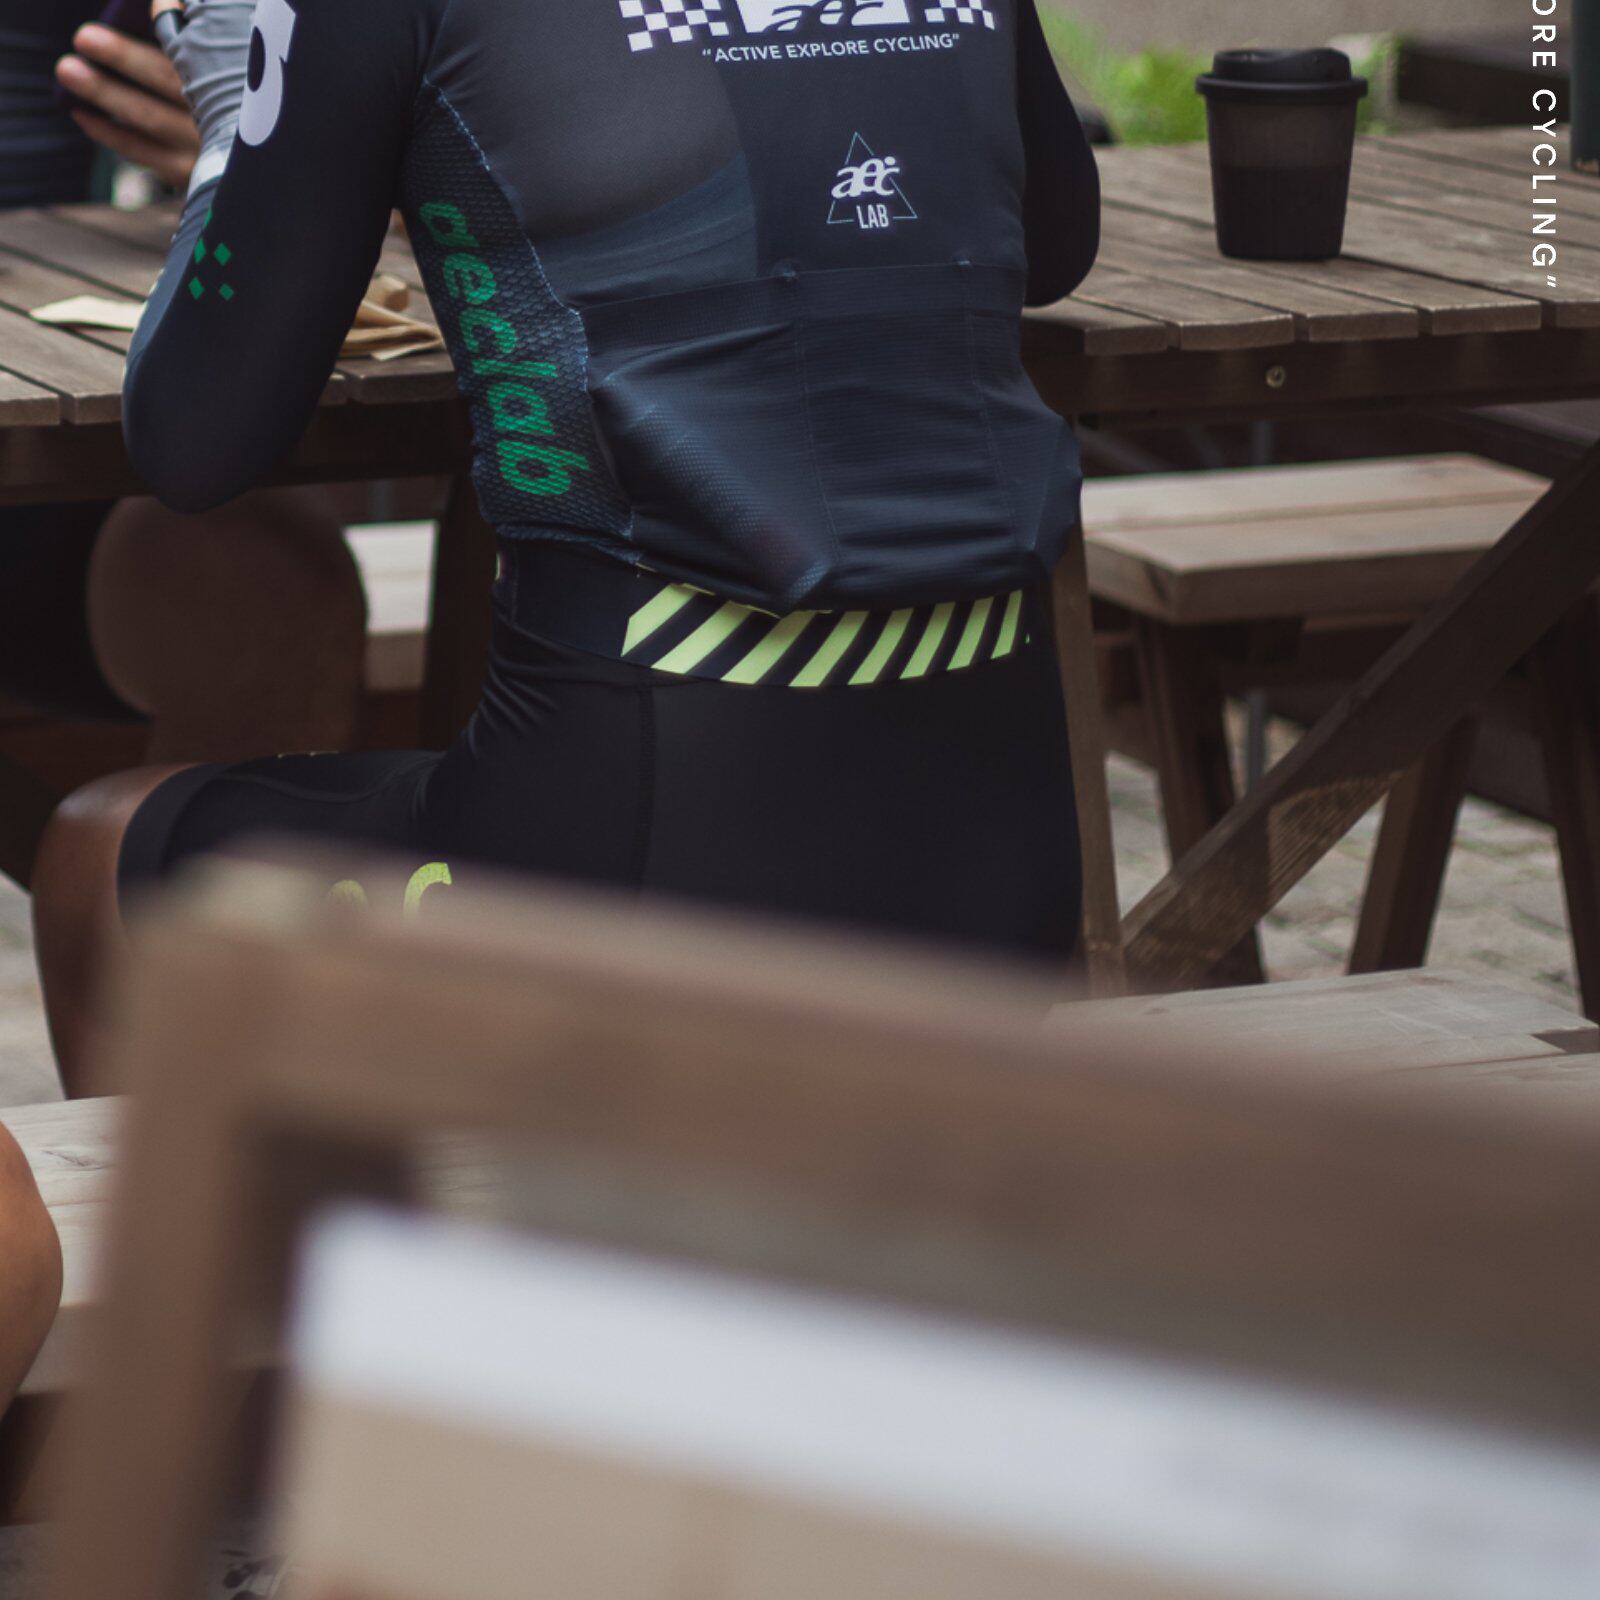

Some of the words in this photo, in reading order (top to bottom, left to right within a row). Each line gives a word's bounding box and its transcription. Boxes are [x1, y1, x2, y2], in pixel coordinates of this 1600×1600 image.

[786, 40, 869, 58] EXPLORE
[856, 203, 889, 229] LAB
[420, 202, 591, 497] aeclab
